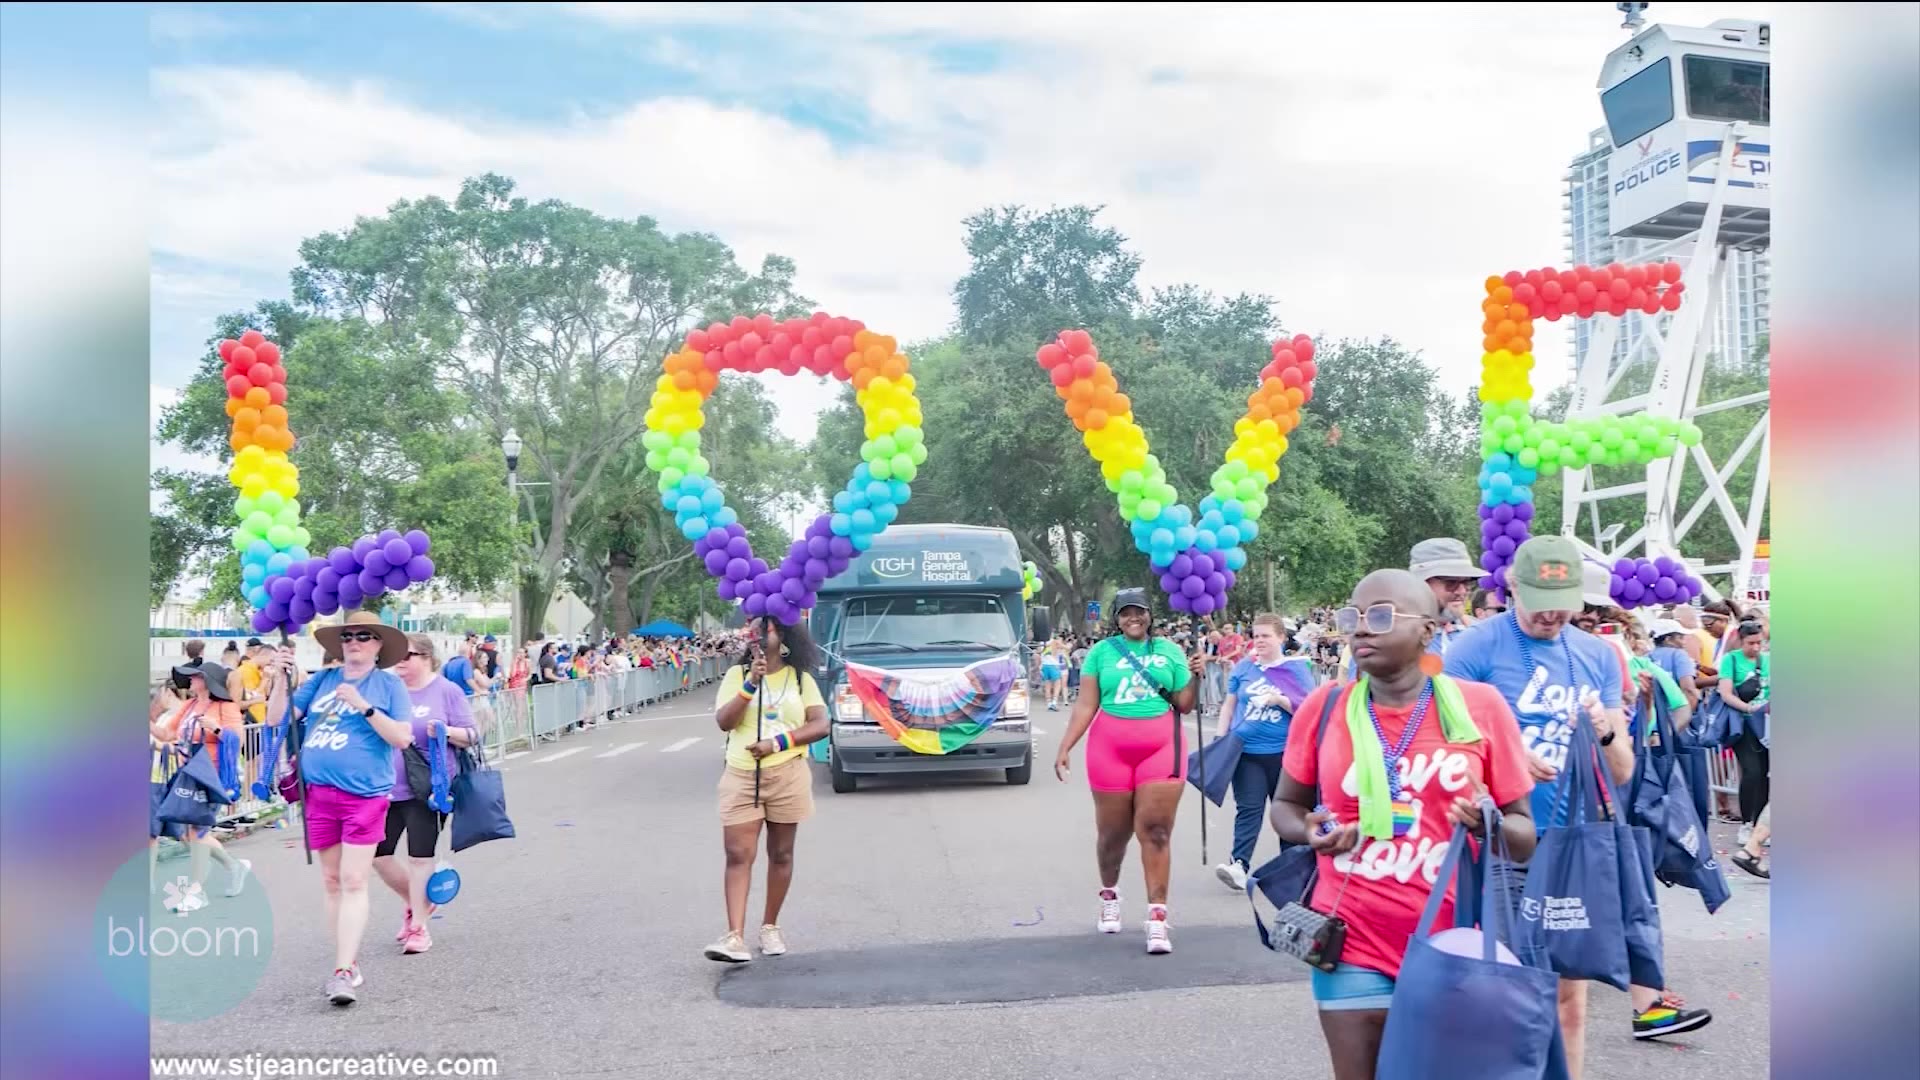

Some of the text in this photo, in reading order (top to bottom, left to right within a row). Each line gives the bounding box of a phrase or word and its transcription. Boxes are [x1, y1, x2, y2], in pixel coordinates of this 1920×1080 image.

[1615, 152, 1681, 196] POLICE
[1750, 159, 1770, 176] P
[875, 557, 915, 573] TGH
[920, 550, 962, 563] Tampa
[921, 560, 968, 571] General
[1115, 651, 1168, 669] Lve
[1114, 677, 1165, 704] Lo
[1246, 677, 1283, 696] Lo
[303, 729, 349, 750] ove
